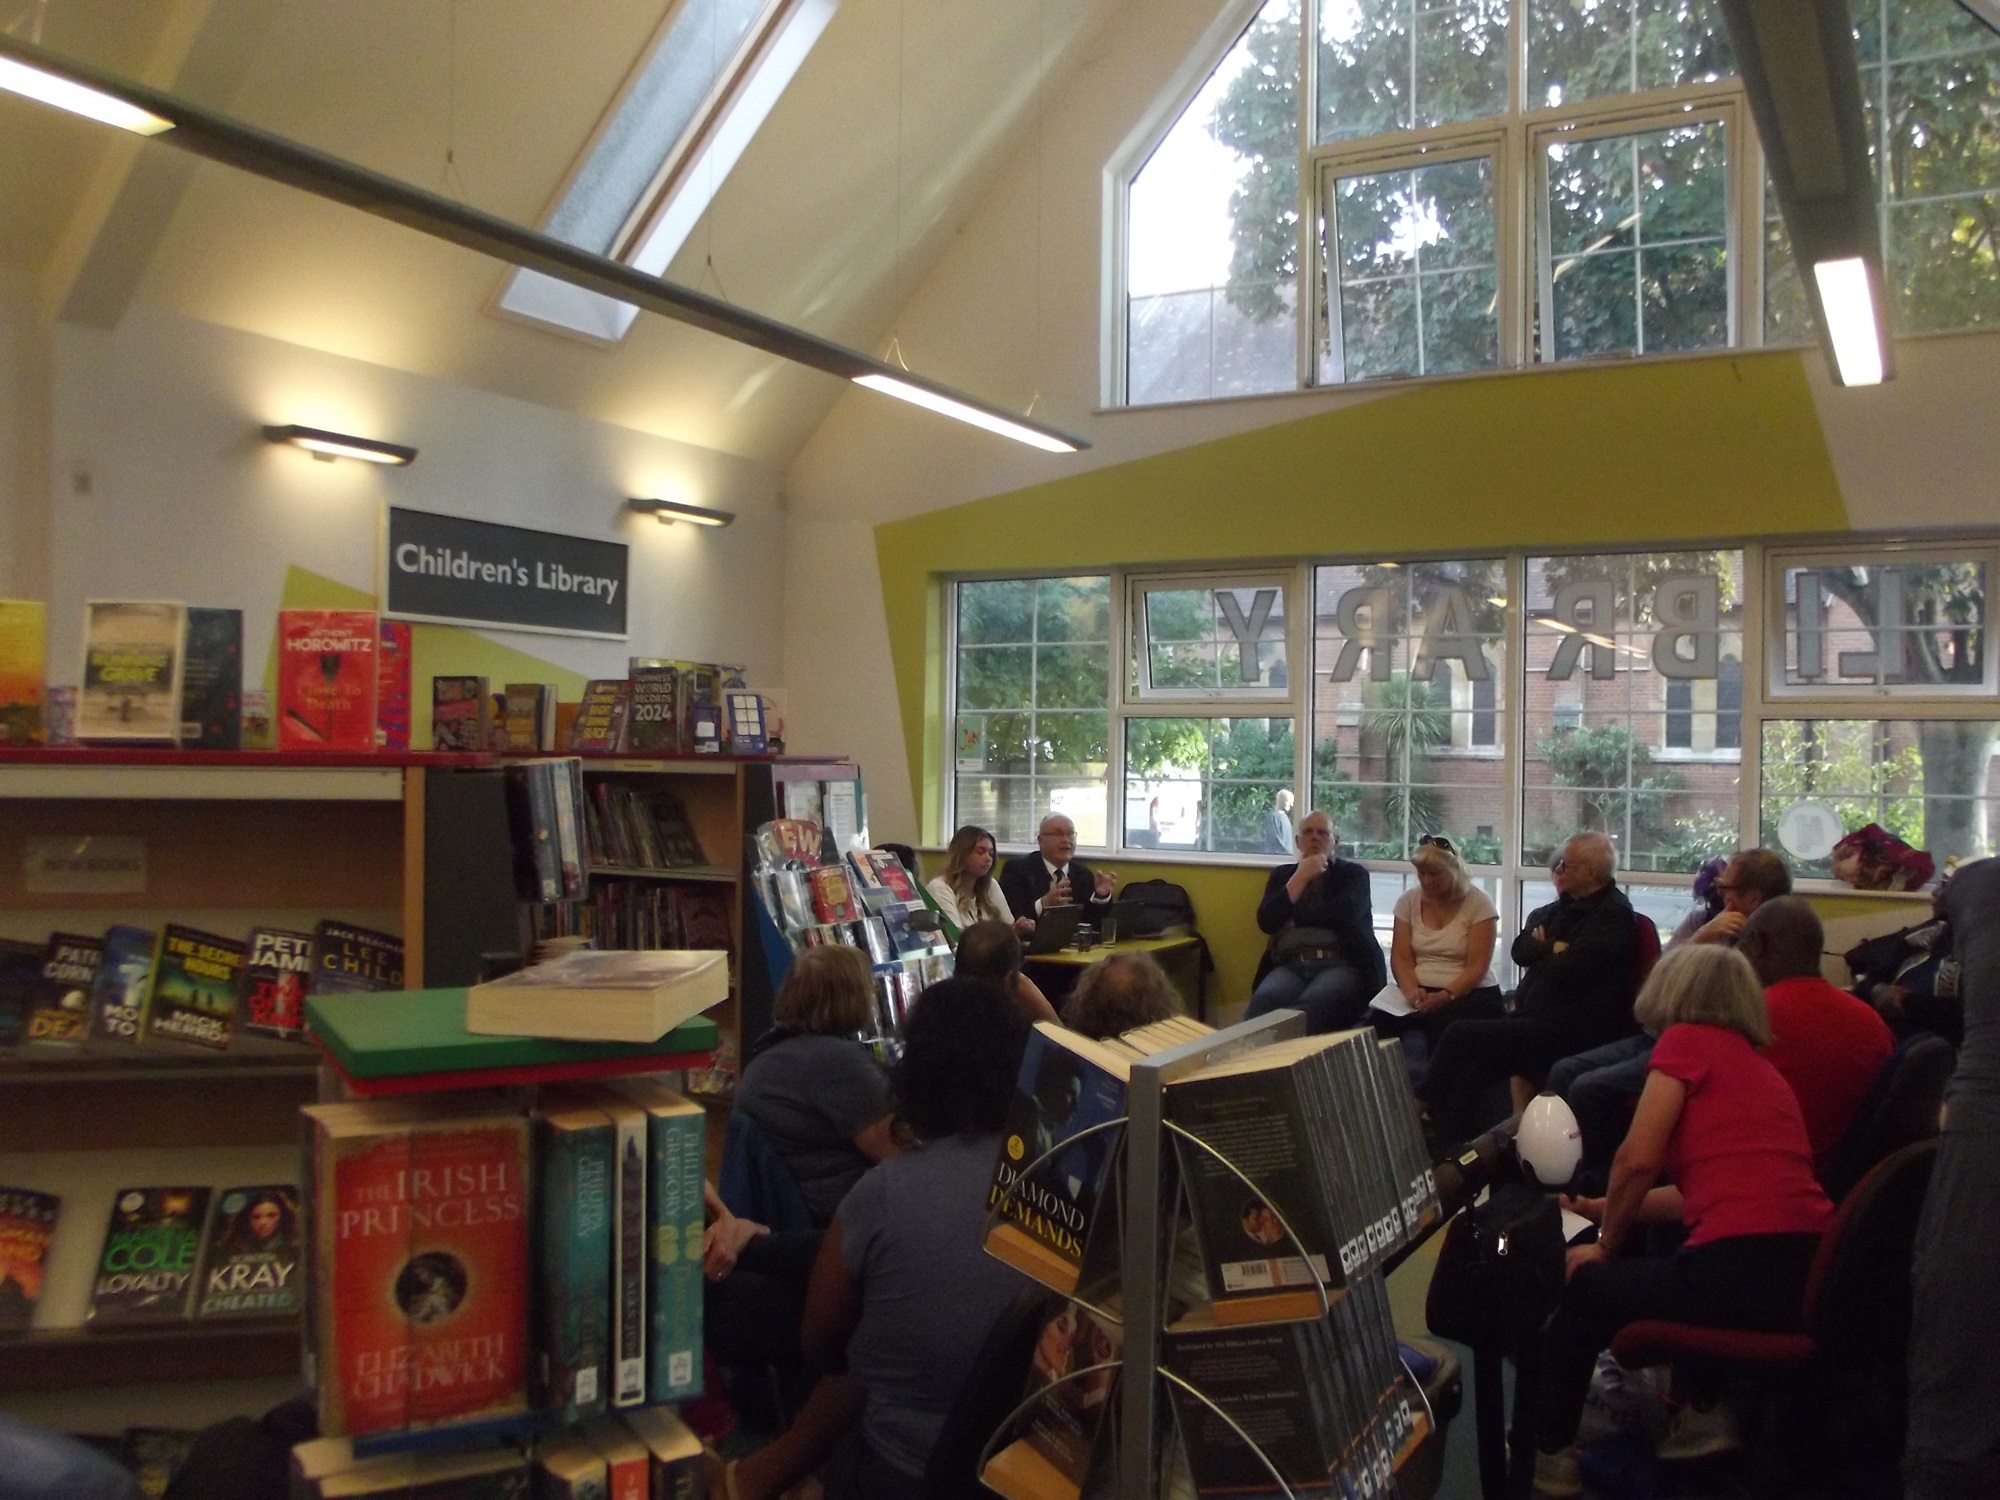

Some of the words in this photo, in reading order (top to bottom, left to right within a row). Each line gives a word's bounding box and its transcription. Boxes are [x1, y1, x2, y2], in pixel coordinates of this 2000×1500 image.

[396, 542, 529, 588] Children's
[536, 561, 619, 605] Library
[286, 637, 373, 653] HOROWITZ
[633, 682, 672, 694] WORLD
[634, 703, 673, 722] 2024
[326, 927, 355, 941] JACK
[357, 934, 404, 953] REACHE
[341, 942, 388, 966] LEE
[322, 952, 403, 986] CHILD
[355, 1184, 391, 1201] THE
[396, 1162, 508, 1202] IRISH
[665, 1126, 682, 1219] GREGORY
[683, 1131, 700, 1211] PHILIPPA
[998, 1162, 1085, 1232] DIAMOND
[339, 1196, 521, 1240] PRINCESS
[990, 1184, 1083, 1258] DEMANDS
[104, 1242, 197, 1273] COLE
[96, 1271, 191, 1296] LOYALTY
[207, 1261, 296, 1293] KRAY
[351, 1356, 507, 1400] CHADWICK
